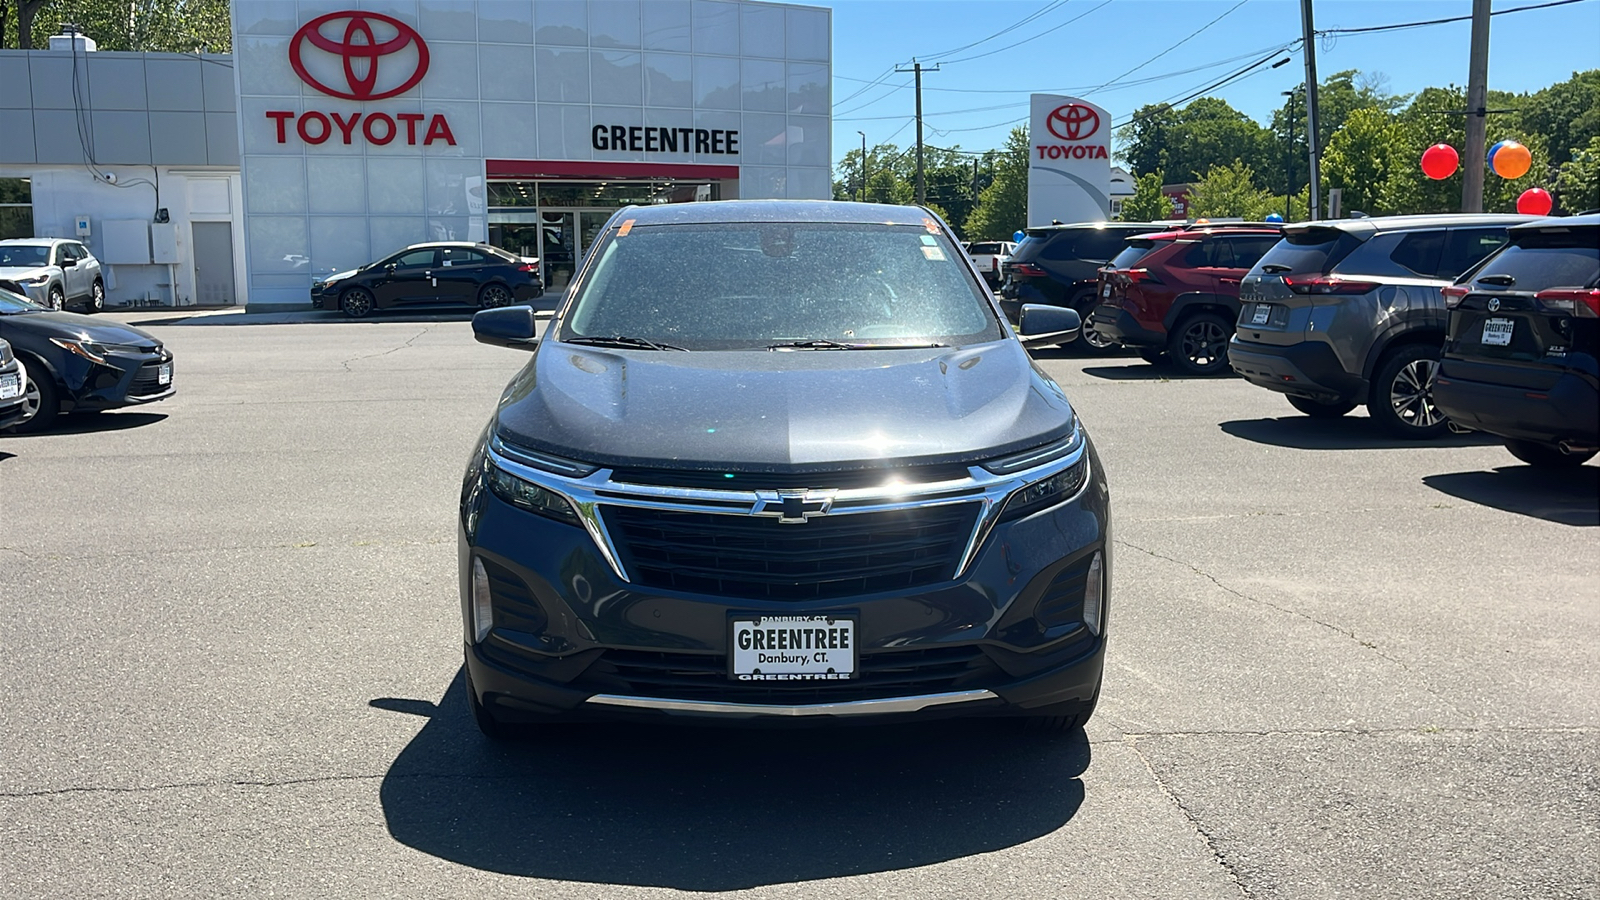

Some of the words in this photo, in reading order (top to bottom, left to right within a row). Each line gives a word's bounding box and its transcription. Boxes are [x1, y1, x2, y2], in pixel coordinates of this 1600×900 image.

[266, 111, 457, 146] TOYOTA
[592, 125, 739, 154] GREENTREE
[1036, 145, 1108, 160] TOYOTA
[1484, 322, 1513, 334] GREENTREE
[738, 628, 849, 650] GREENTREE
[758, 652, 810, 666] Danbury,
[813, 652, 829, 663] CT.
[738, 673, 851, 681] GREENTREE
